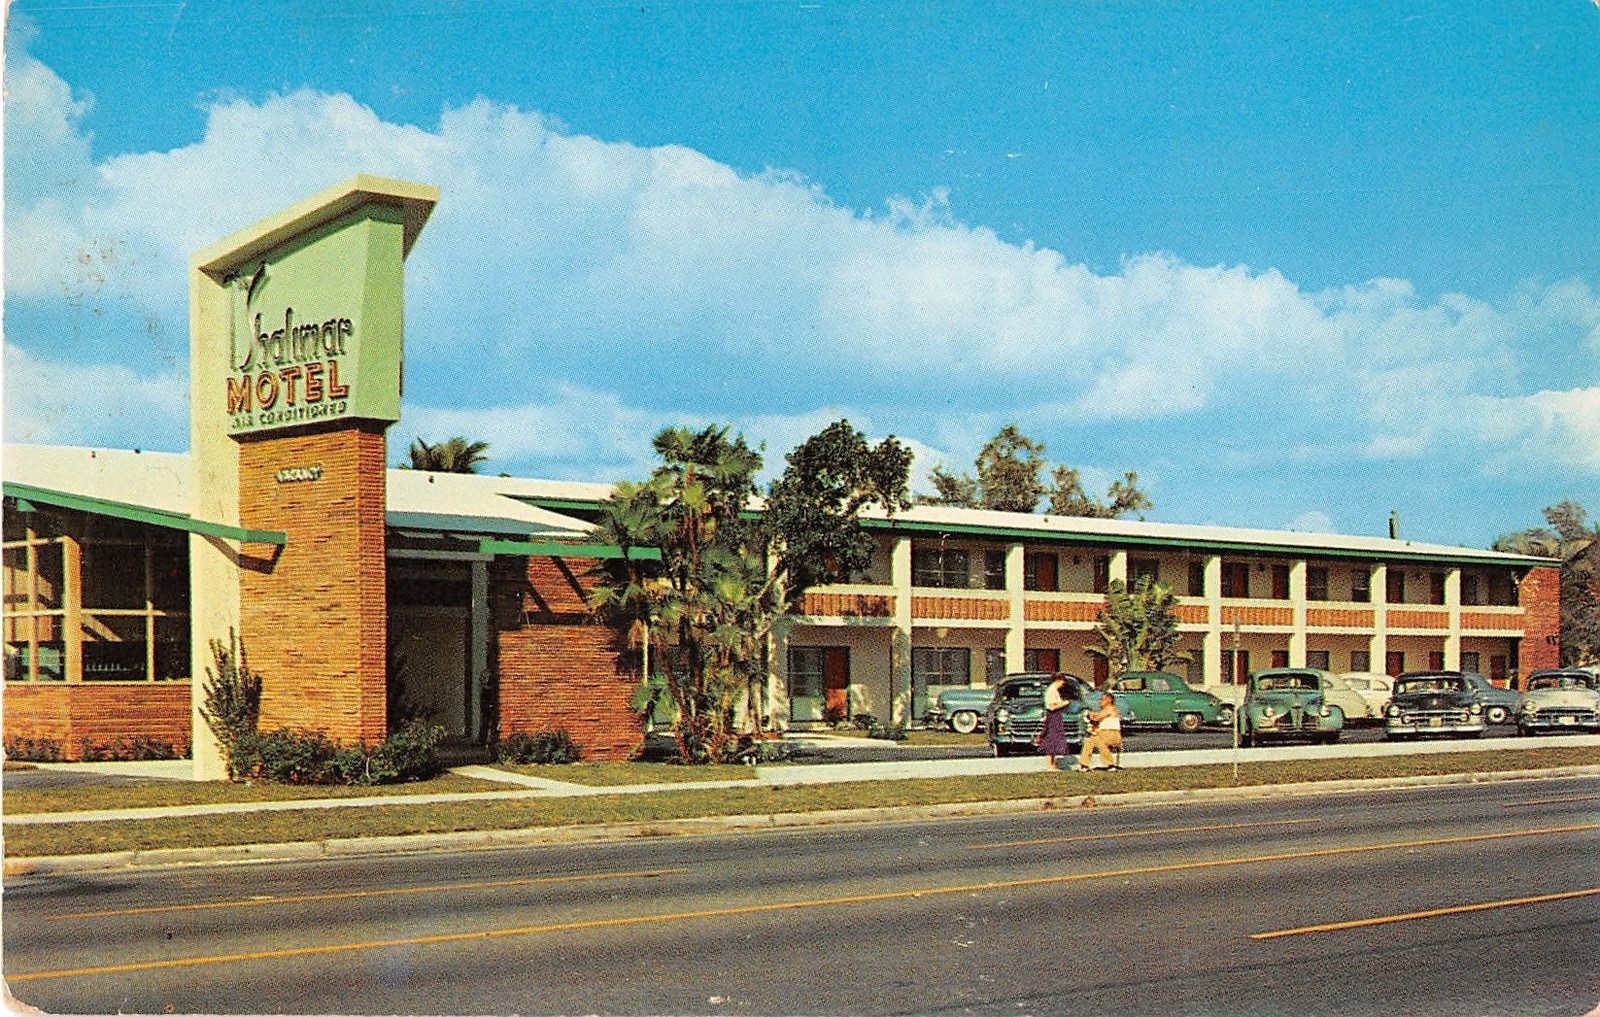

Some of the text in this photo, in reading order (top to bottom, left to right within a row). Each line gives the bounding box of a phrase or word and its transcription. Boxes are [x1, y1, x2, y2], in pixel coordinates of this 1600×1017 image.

[226, 360, 349, 414] MOTEL
[231, 401, 348, 429] AIR CONDITIONED
